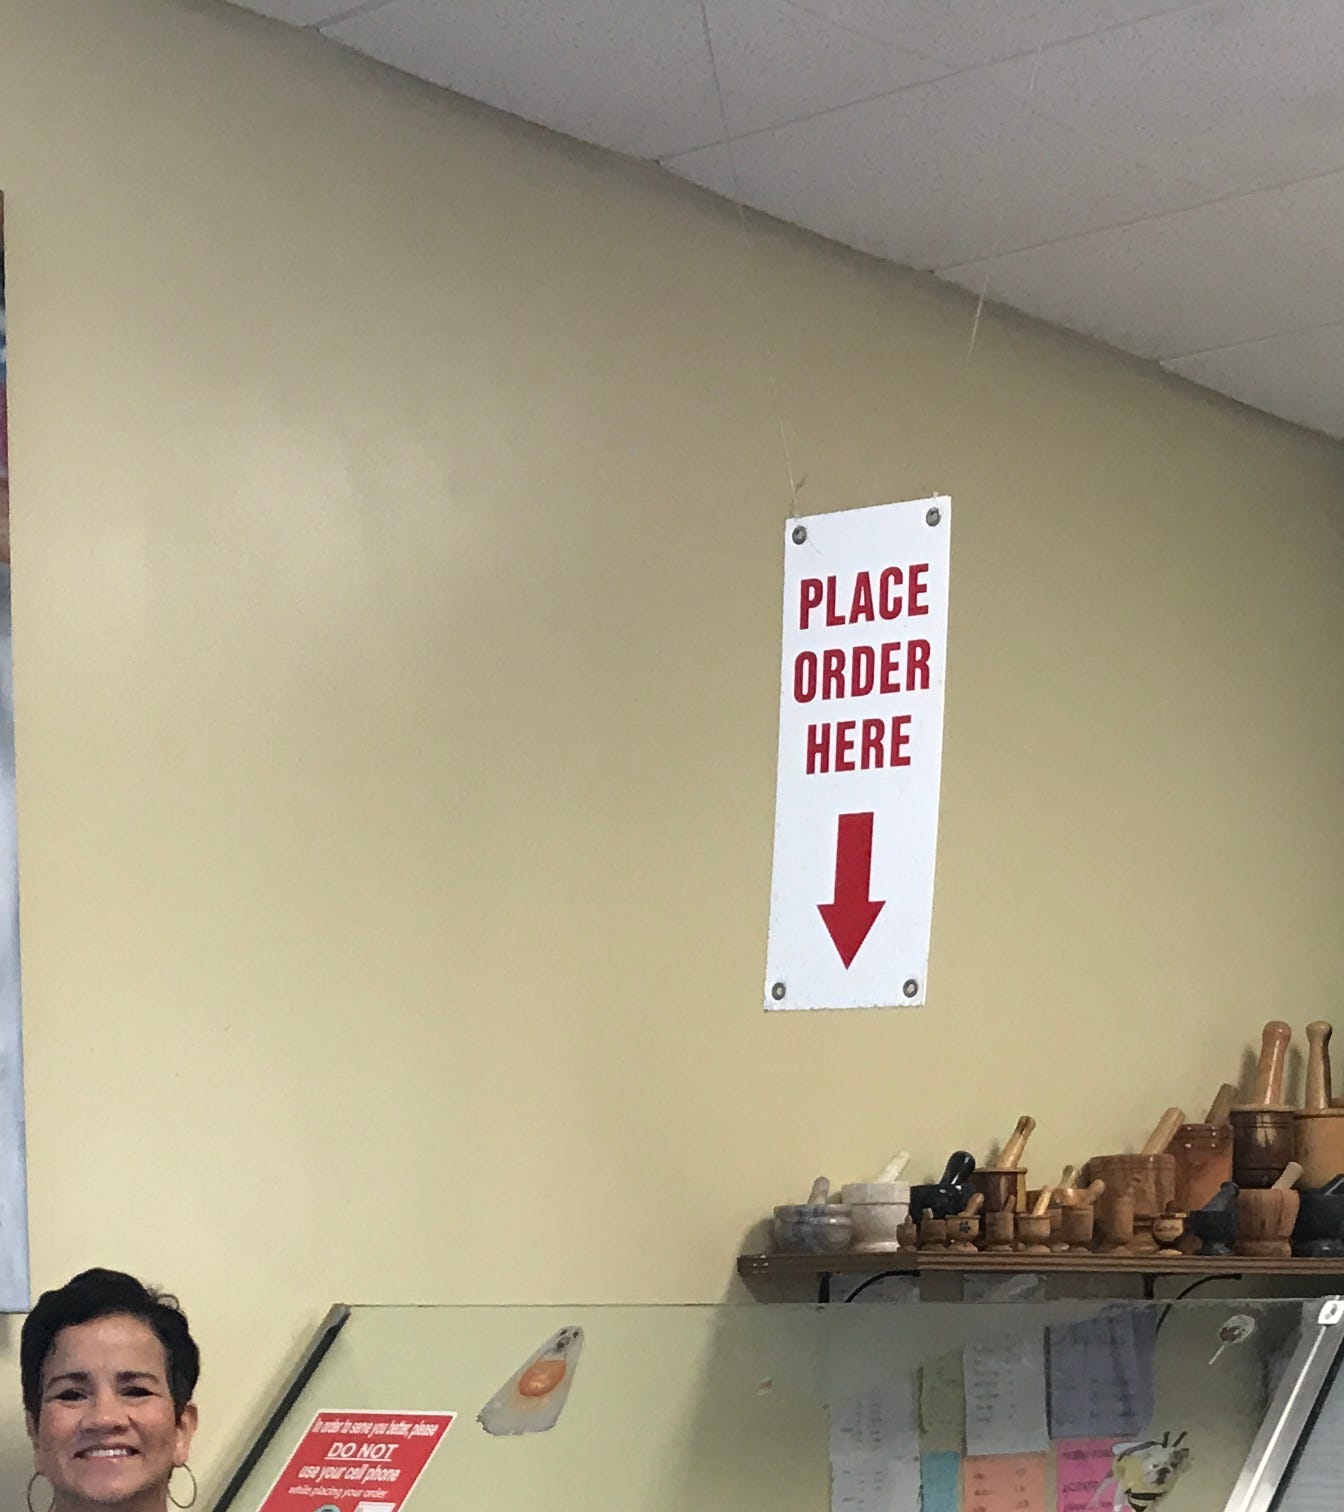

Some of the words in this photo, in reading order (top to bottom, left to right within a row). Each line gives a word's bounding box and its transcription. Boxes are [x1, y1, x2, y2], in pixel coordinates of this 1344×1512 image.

[798, 562, 929, 630] PLACE
[792, 638, 931, 704] ORDER
[805, 714, 913, 775] HERE
[298, 1465, 321, 1479] use
[316, 1466, 347, 1483] your
[344, 1463, 369, 1480] cell
[360, 1464, 401, 1484] phone
[327, 1442, 356, 1459] DO
[357, 1443, 399, 1460] NOT
